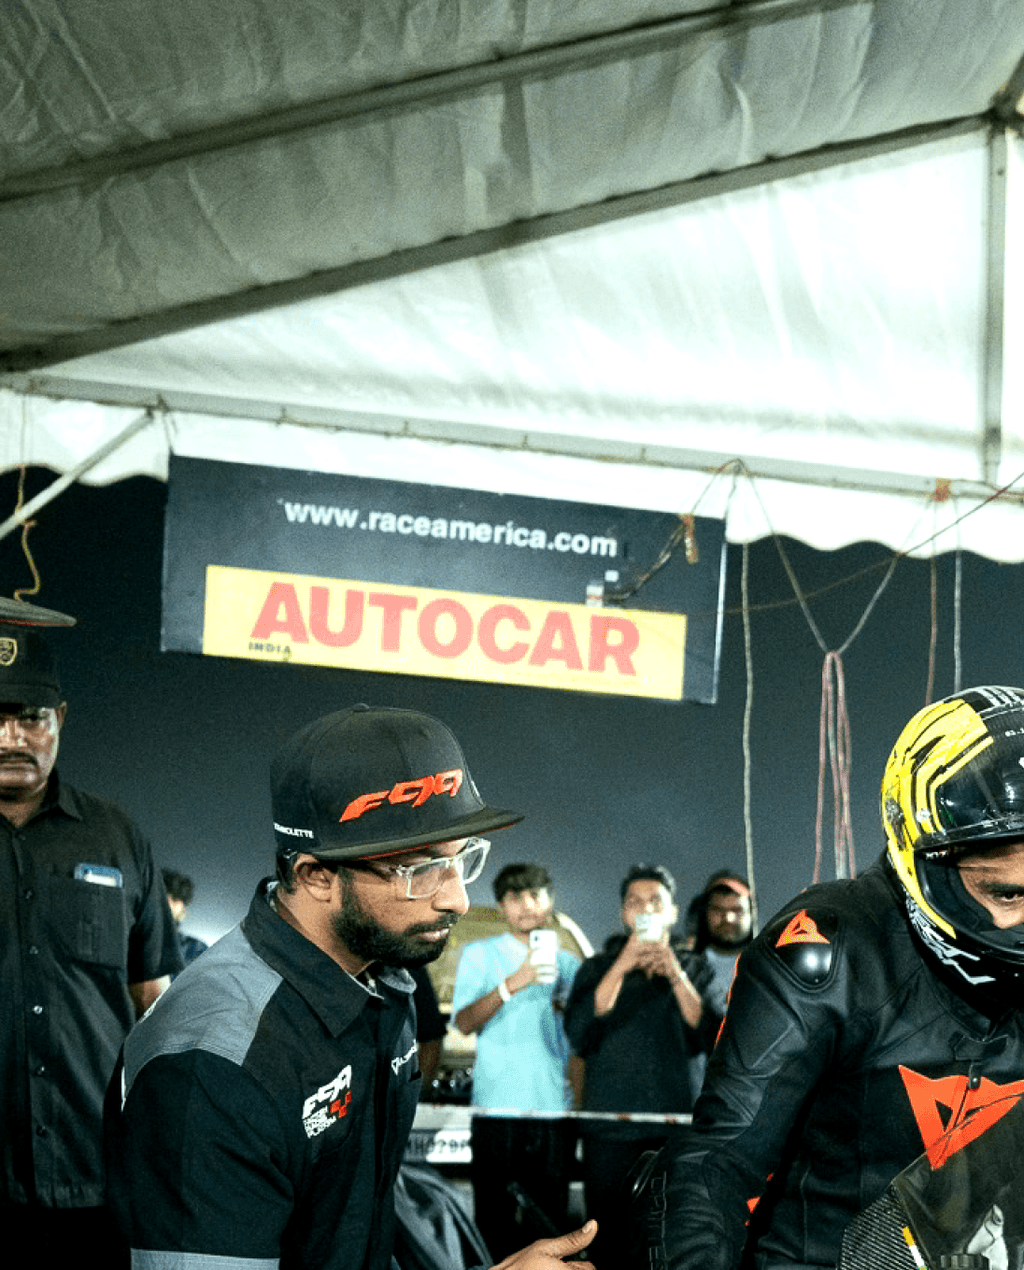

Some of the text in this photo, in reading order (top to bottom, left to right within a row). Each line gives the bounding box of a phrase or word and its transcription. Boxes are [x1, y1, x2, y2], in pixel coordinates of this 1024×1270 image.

[284, 500, 618, 557] www.raceamerica.com
[248, 642, 292, 654] INDIA
[251, 581, 641, 677] AUTOCAR
